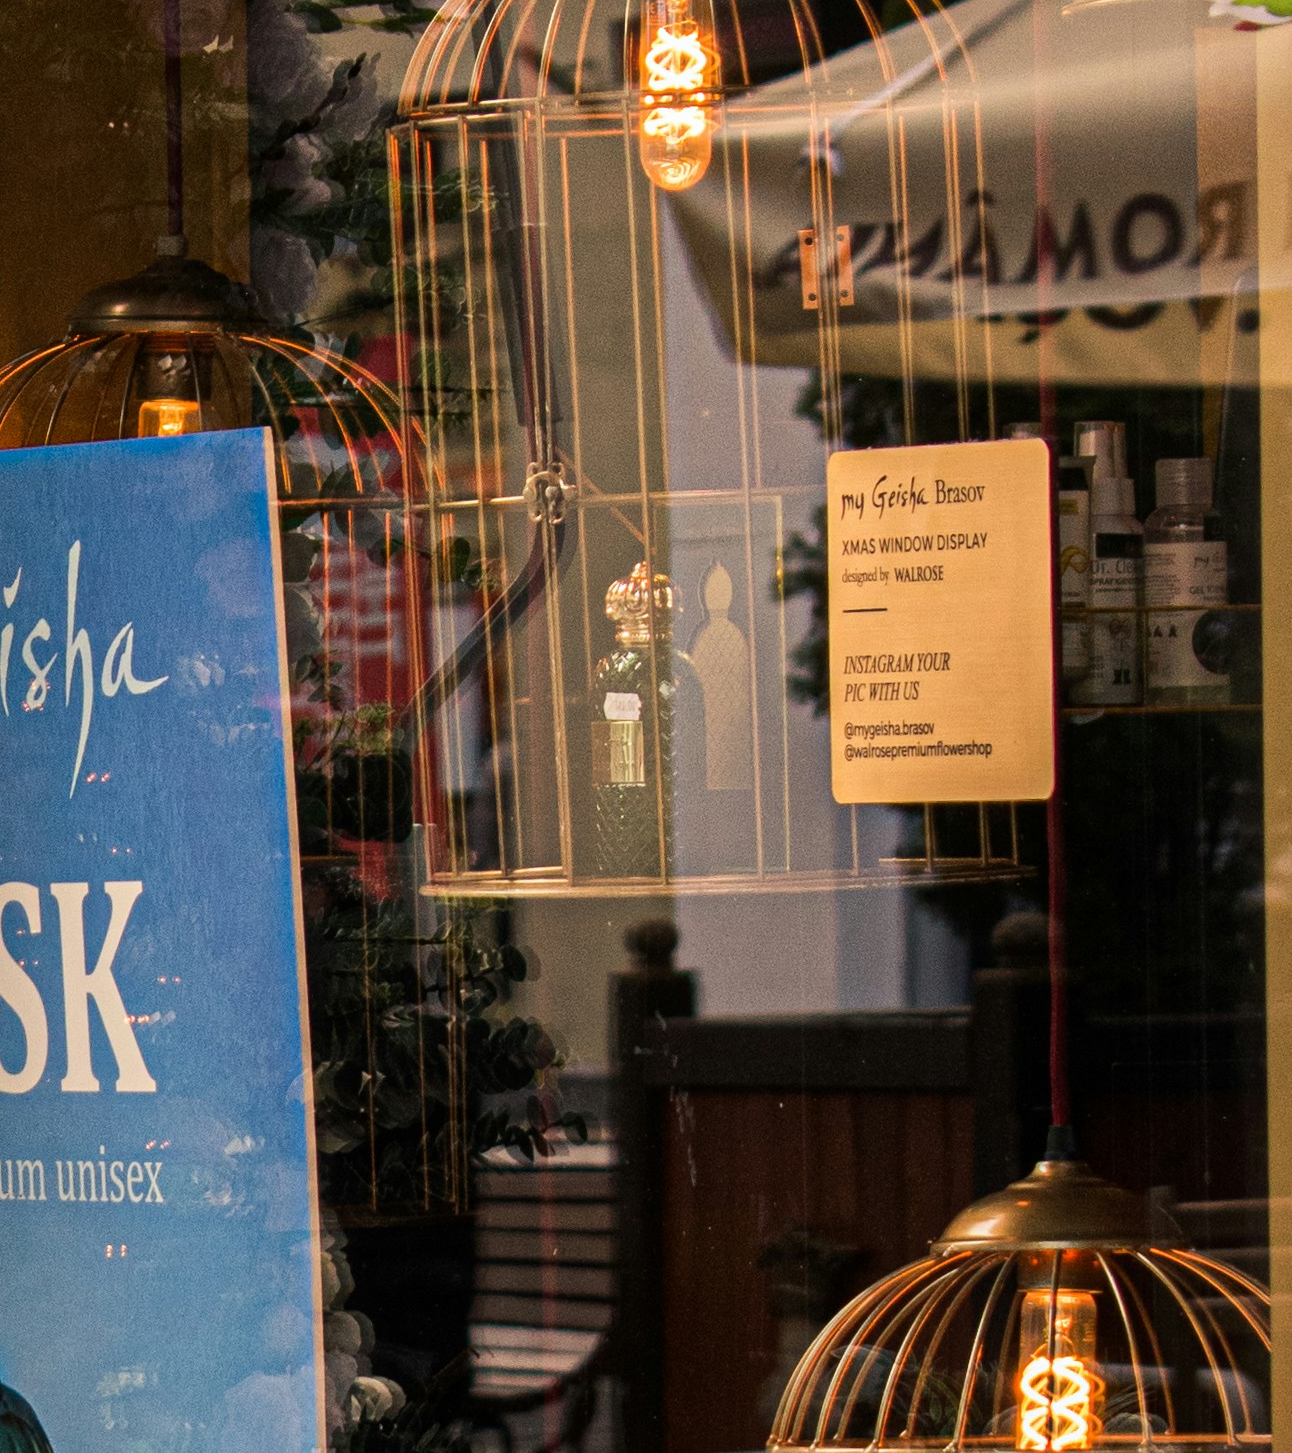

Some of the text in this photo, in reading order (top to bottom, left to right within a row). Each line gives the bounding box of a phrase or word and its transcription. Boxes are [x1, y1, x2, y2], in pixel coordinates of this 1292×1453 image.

[841, 475, 985, 520] my Geisha Brasov
[842, 533, 988, 555] XMAS WINDOW DISPLAY
[842, 565, 944, 587] designed by WALROSE
[844, 652, 951, 674] INSTAGRAM YOUR
[844, 681, 920, 702] PIC WITH US
[844, 720, 935, 739] @mygeisha.brasov
[844, 740, 993, 761] @walrosepremiumflowershop
[55, 1145, 165, 1203] unisex
